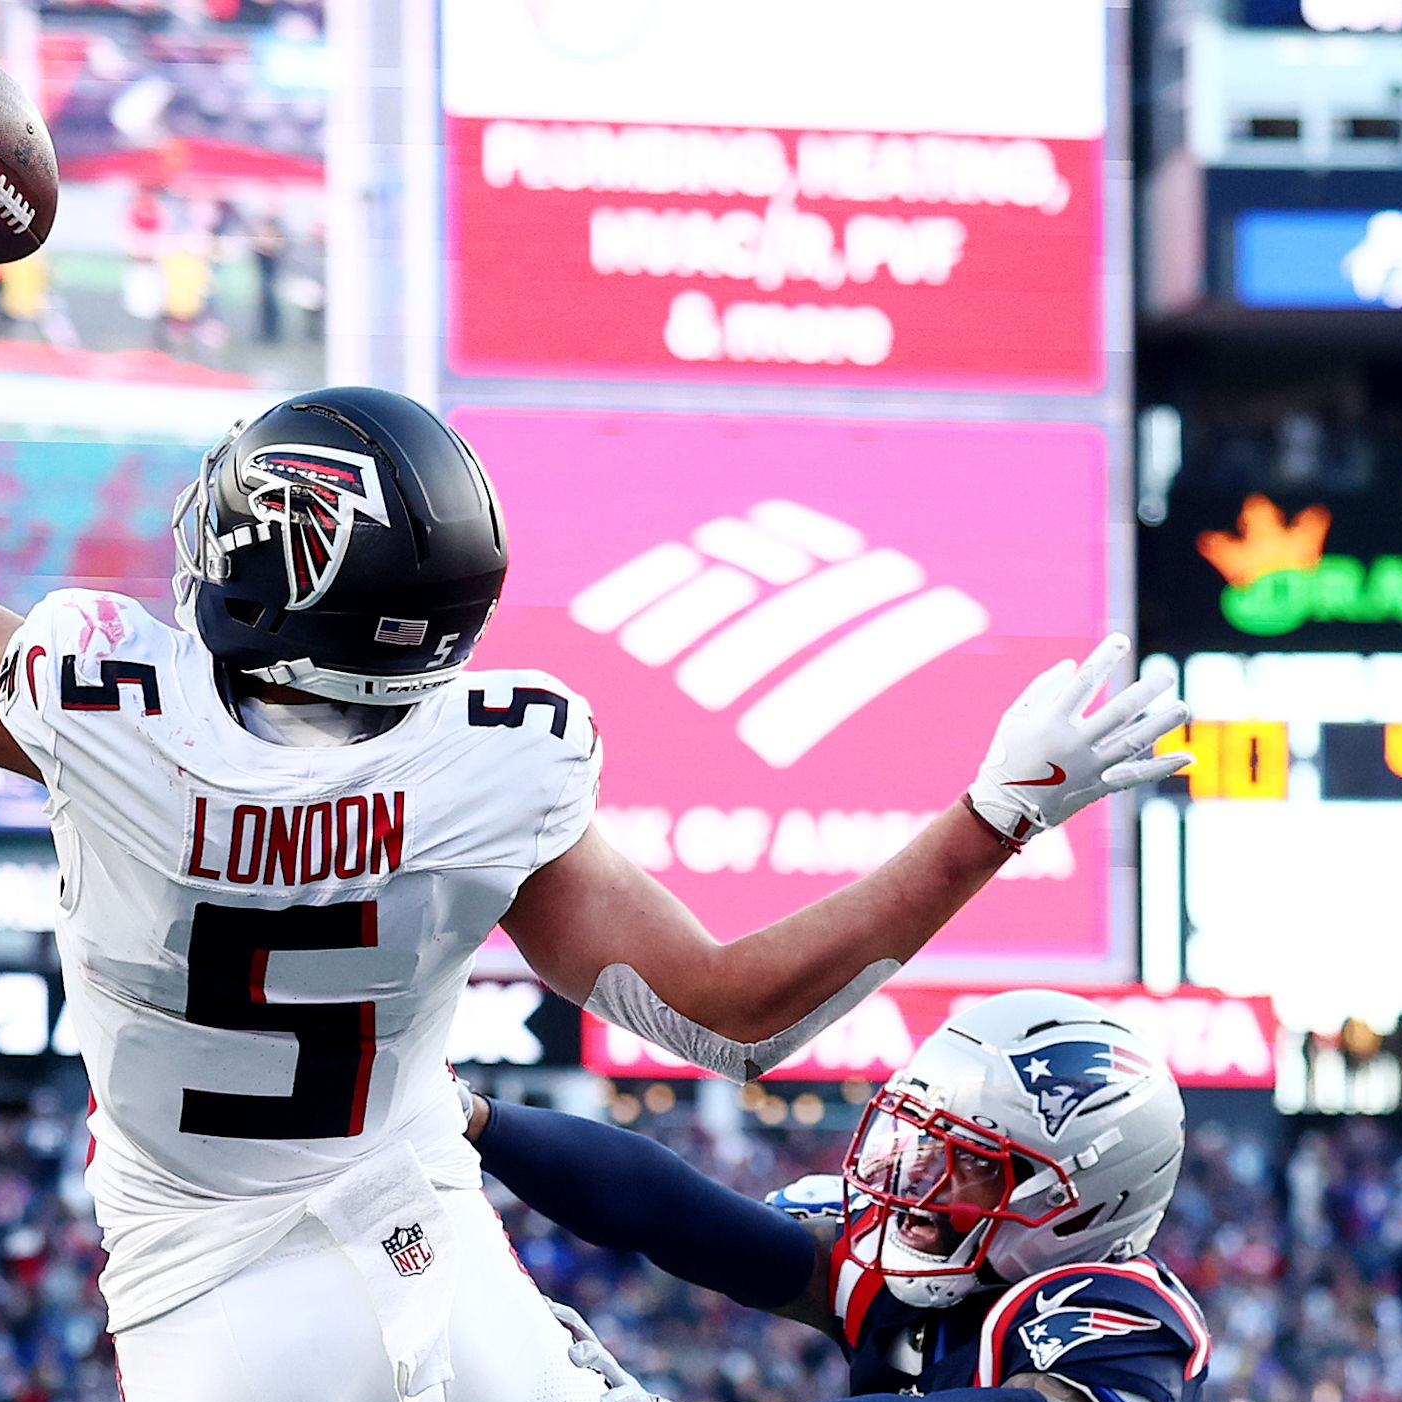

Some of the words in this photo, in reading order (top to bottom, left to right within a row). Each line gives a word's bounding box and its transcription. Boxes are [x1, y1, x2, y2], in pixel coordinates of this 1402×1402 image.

[425, 632, 460, 668] 5
[61, 654, 161, 715] 5
[467, 687, 568, 740] 5
[189, 791, 405, 886] LONDON
[179, 899, 378, 1141] 5
[394, 1242, 431, 1273] NFL
